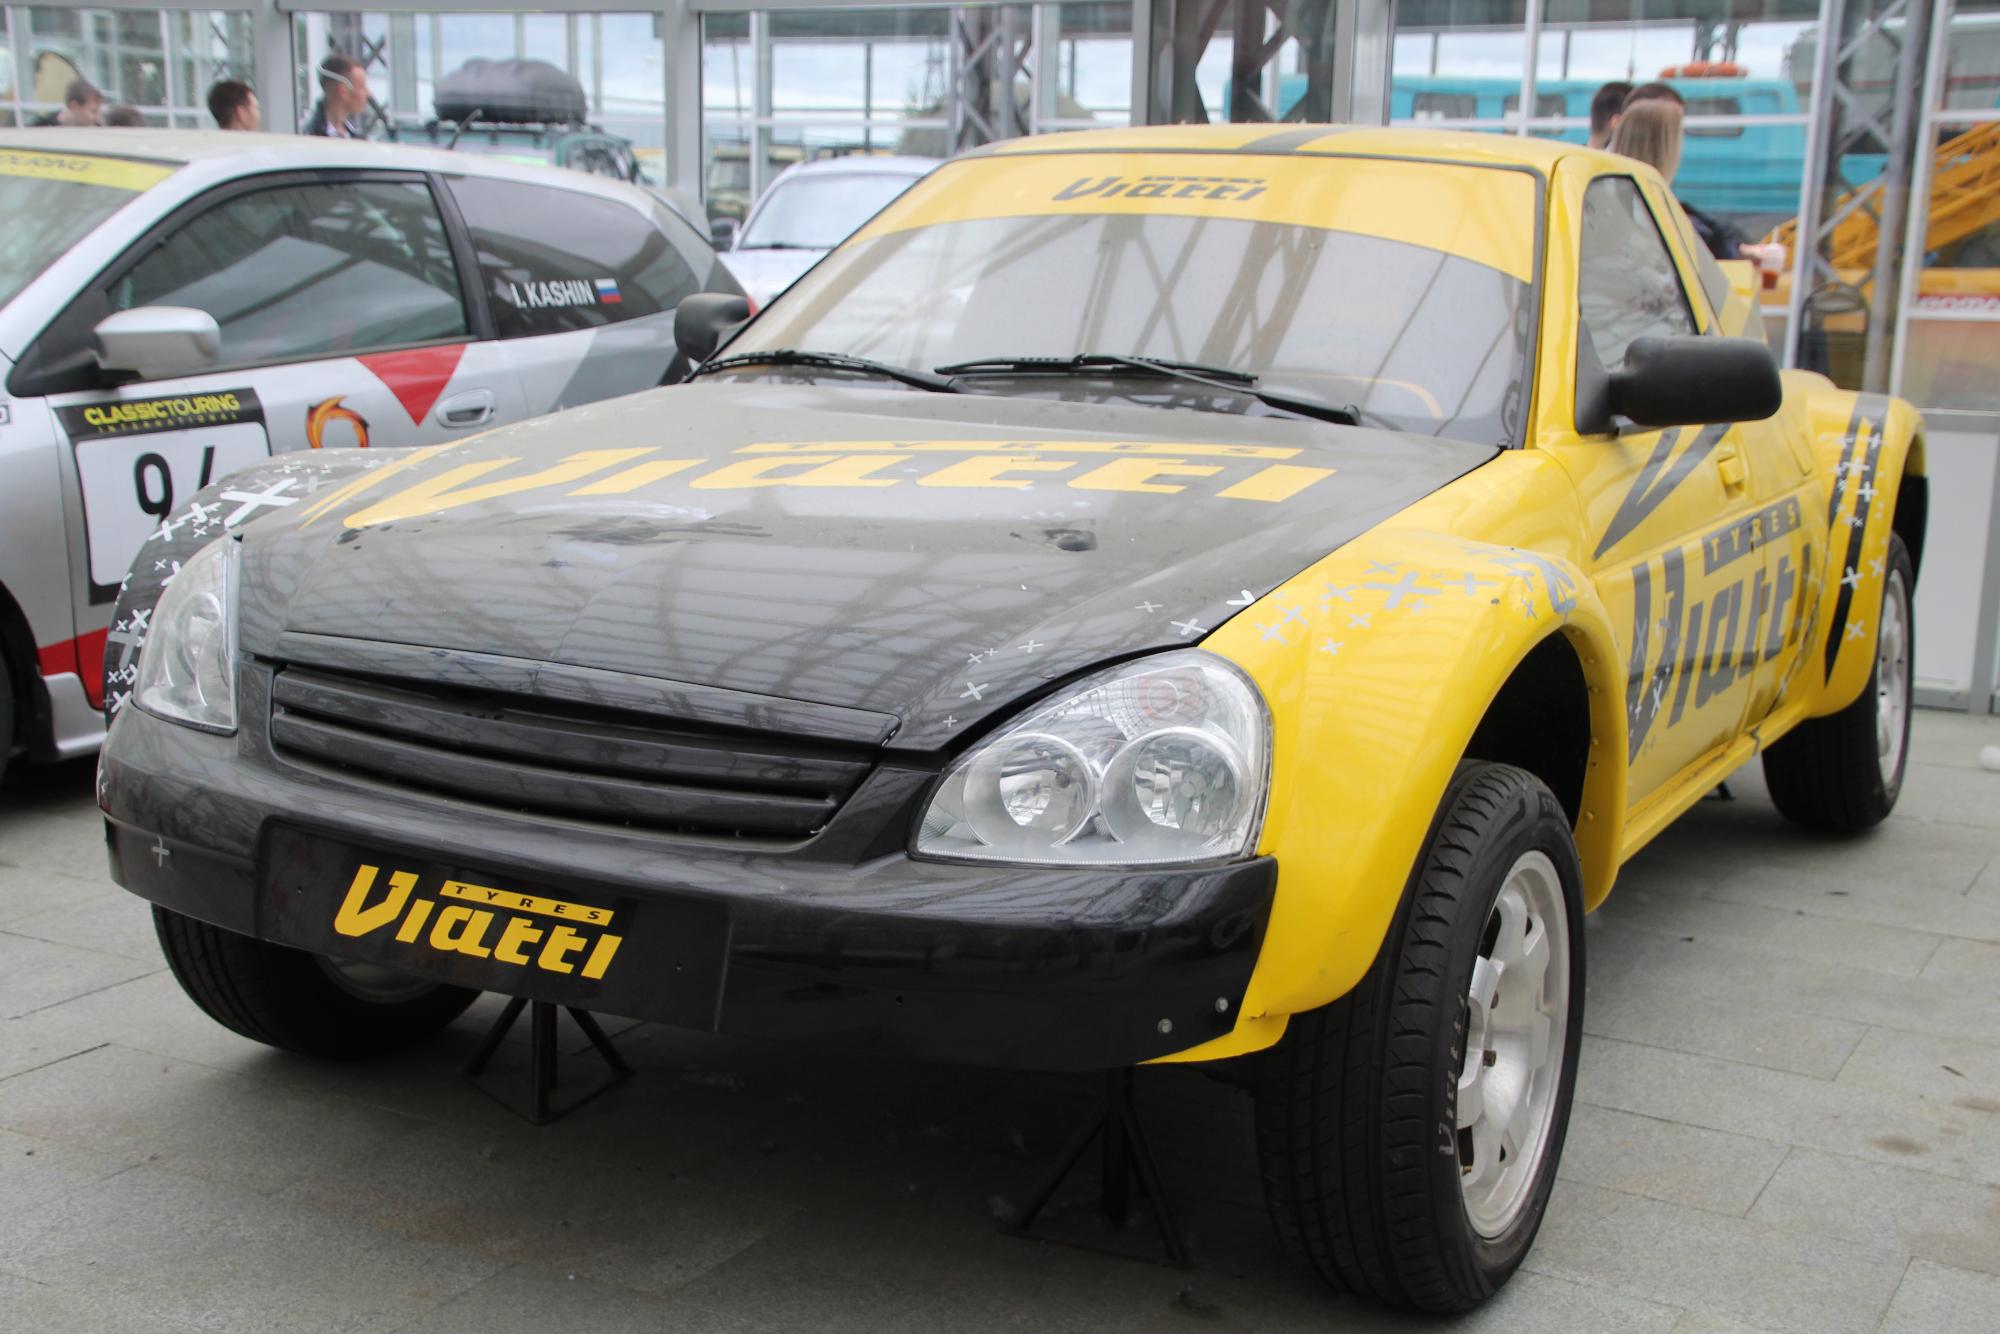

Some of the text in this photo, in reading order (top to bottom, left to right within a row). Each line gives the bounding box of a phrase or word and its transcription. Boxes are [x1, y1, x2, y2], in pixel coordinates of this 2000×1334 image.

[1051, 175, 1268, 202] Viatti
[523, 279, 596, 308] KASHIN
[343, 446, 1337, 528] Viatti
[1709, 502, 1797, 562] TYRES
[334, 863, 623, 980] Viatti
[454, 884, 602, 921] TYRES
